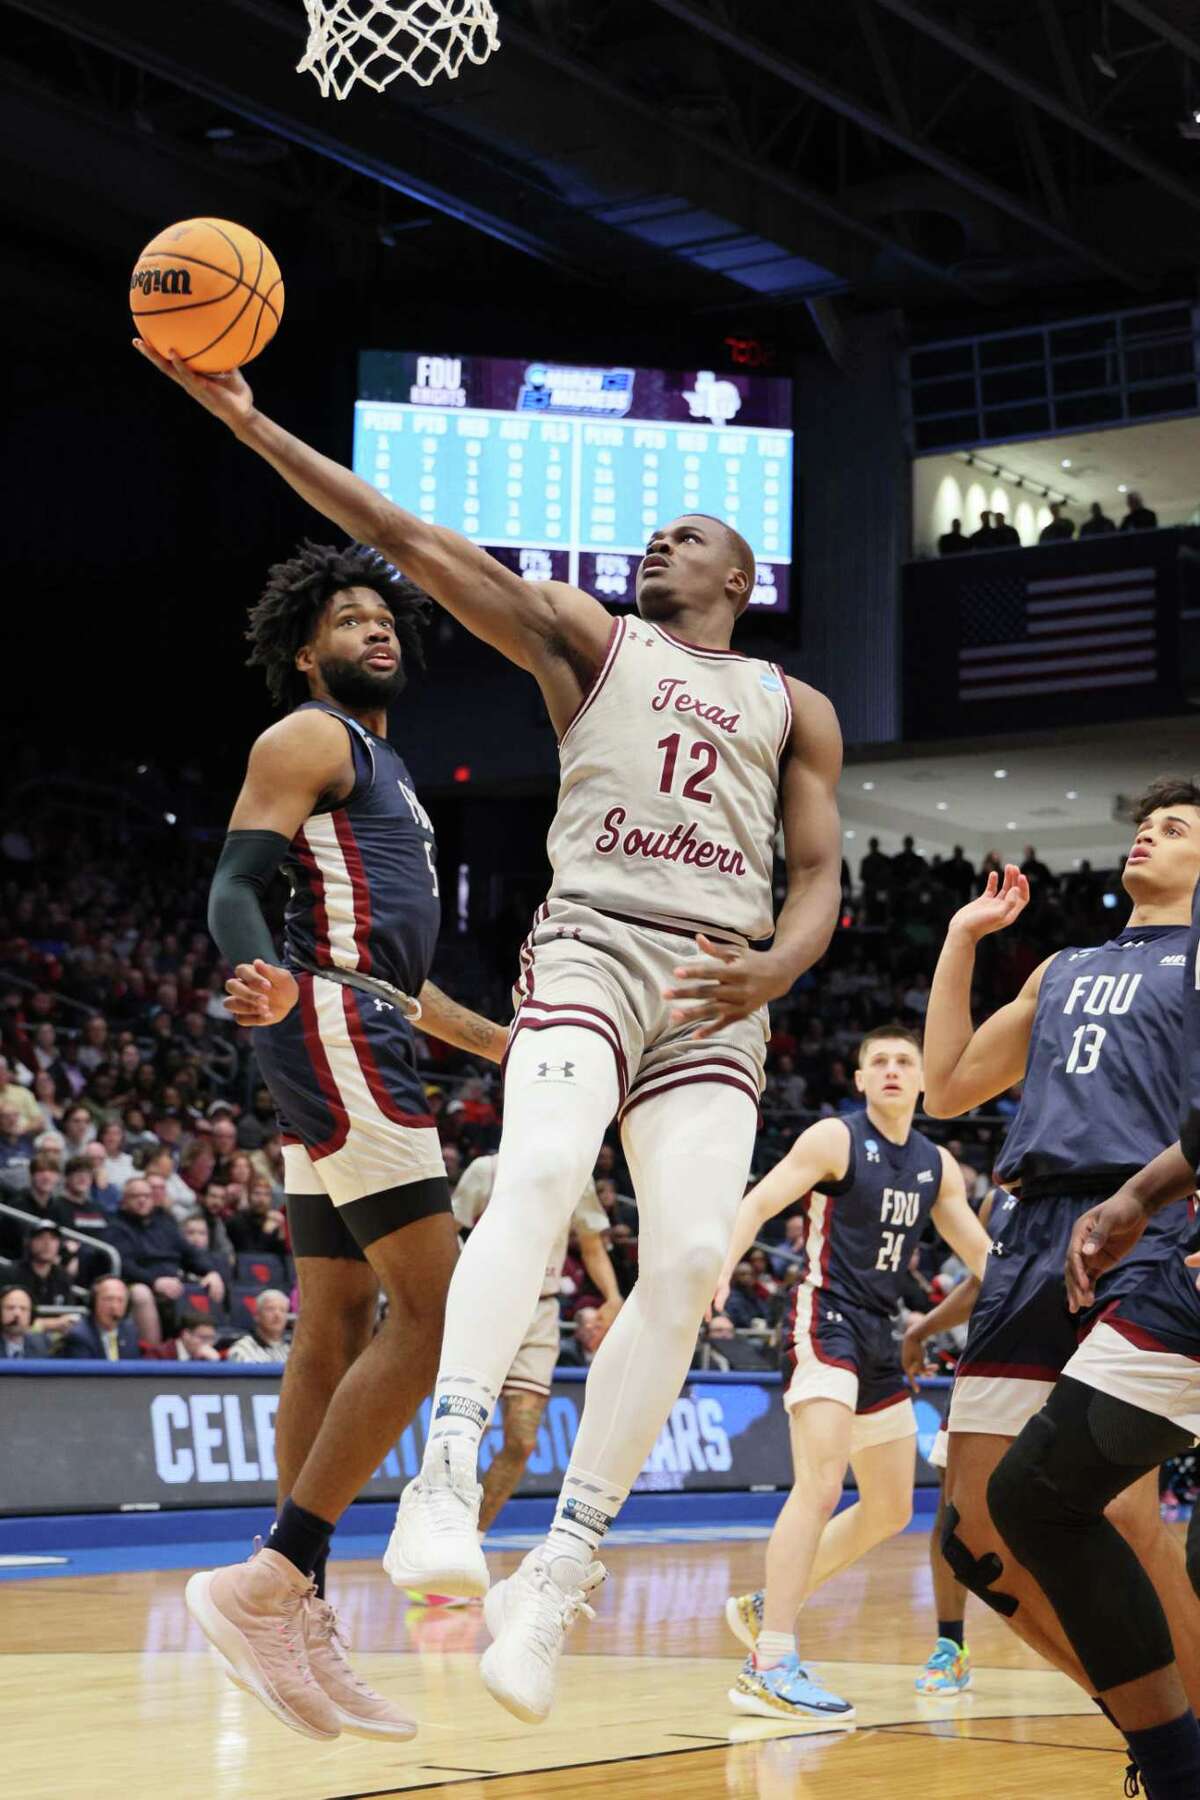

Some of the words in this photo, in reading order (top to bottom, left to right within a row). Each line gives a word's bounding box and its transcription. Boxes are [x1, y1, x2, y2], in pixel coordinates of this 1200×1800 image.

[130, 269, 193, 296] Wilso
[417, 356, 462, 389] FDU
[651, 678, 741, 734] Texas
[657, 732, 719, 805] 12
[595, 807, 746, 876] Southern
[1063, 973, 1143, 1015] FDU
[1065, 1023, 1107, 1074] 13
[880, 1187, 920, 1227] FDU
[875, 1231, 905, 1272] 24
[448, 1395, 481, 1413] MARCH
[642, 1398, 733, 1473] ARS
[575, 1502, 608, 1523] MARCH
